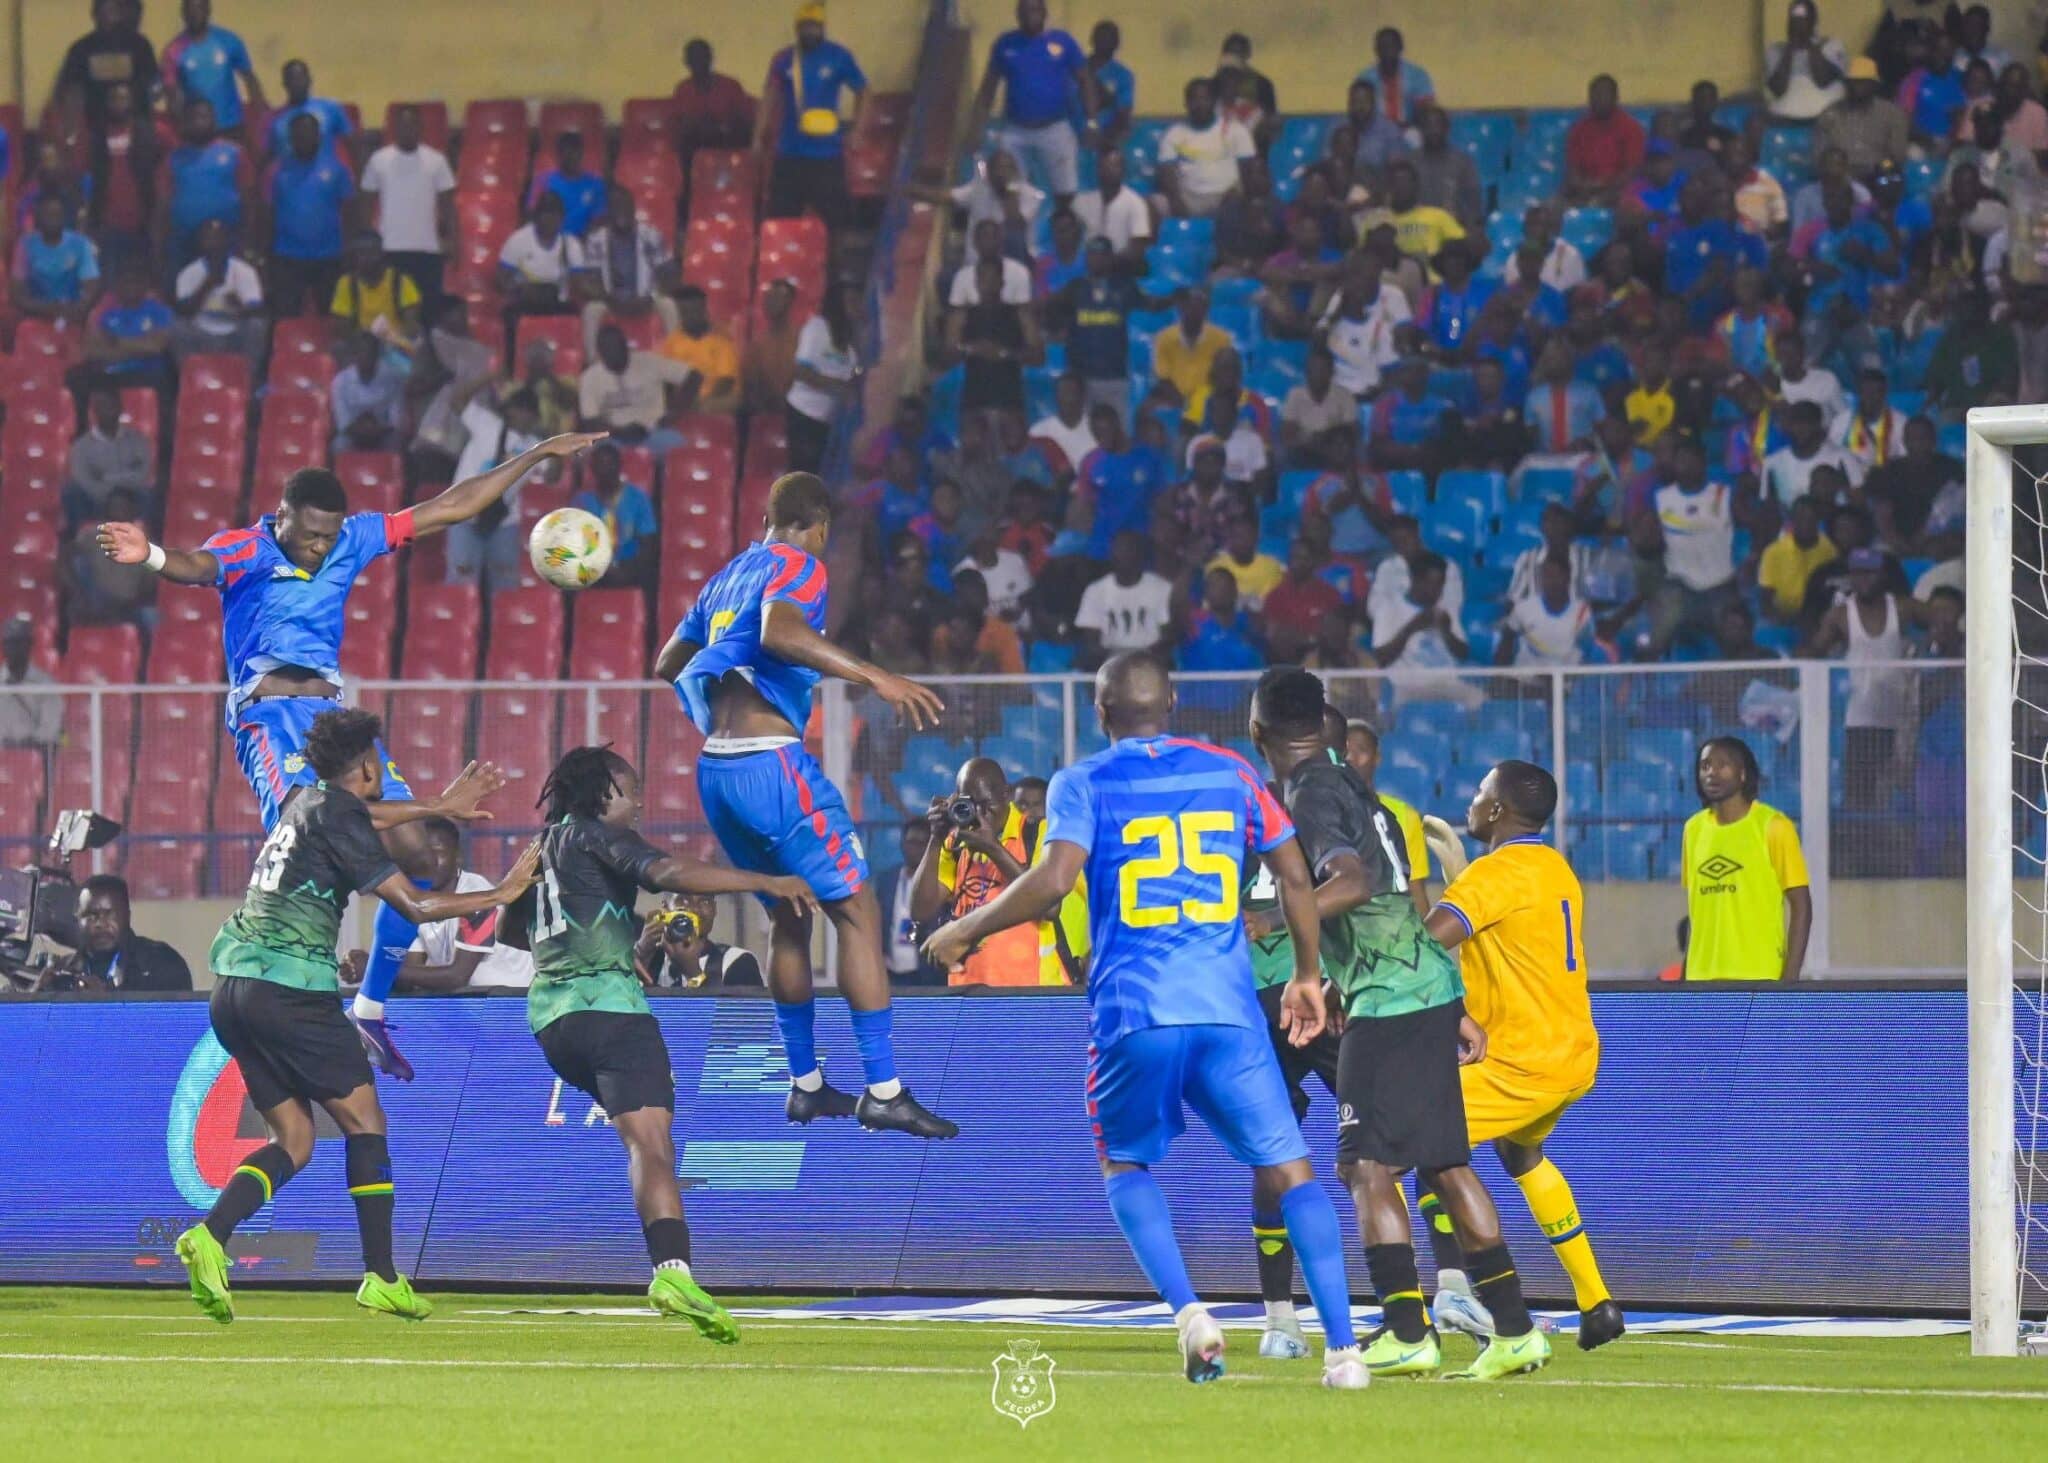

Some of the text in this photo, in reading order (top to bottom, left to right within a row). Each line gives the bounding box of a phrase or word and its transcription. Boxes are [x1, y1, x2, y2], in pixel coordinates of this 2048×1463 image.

[535, 868, 567, 943] 11
[1119, 810, 1239, 928] 25
[1700, 883, 1737, 895] umbro
[1561, 899, 1577, 973] 1
